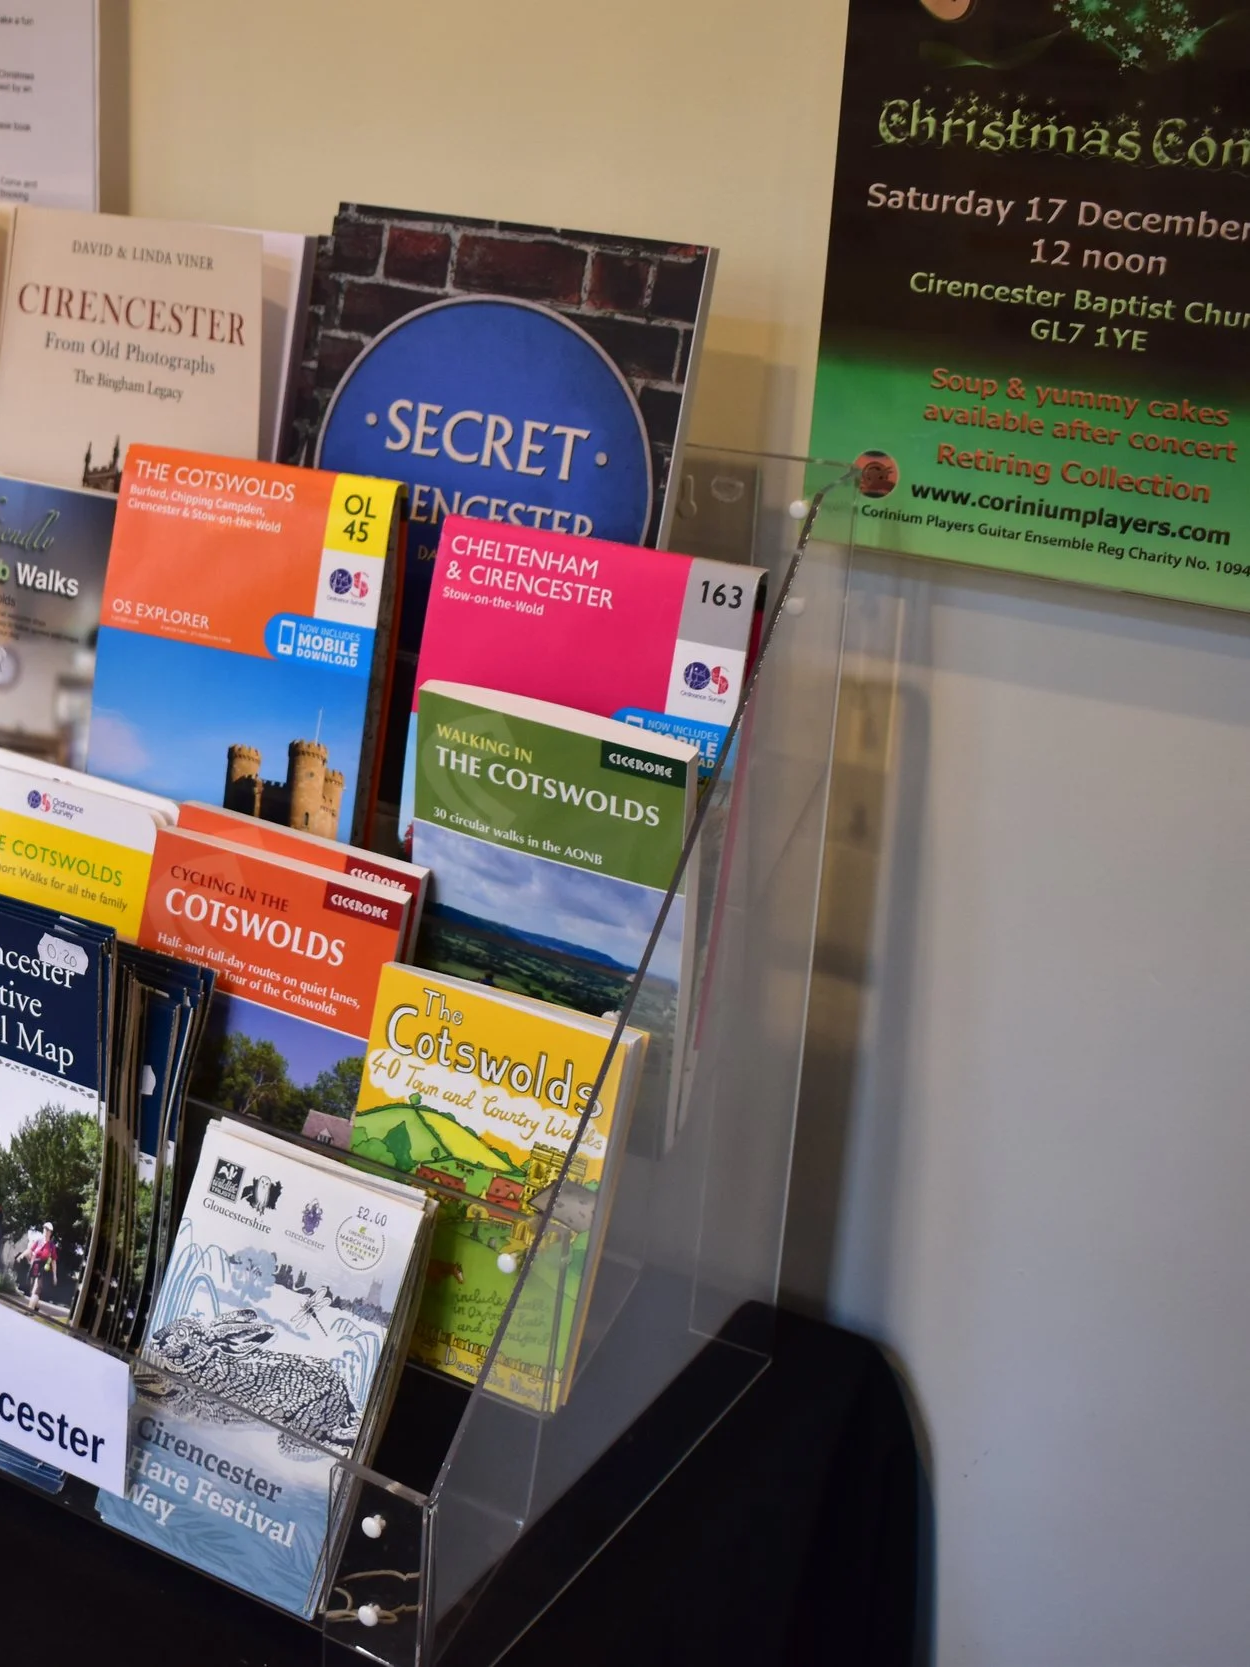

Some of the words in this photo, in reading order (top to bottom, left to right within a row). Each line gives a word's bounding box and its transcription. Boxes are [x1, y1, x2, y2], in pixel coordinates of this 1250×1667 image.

[878, 98, 1143, 162] Christmas
[867, 183, 1014, 226] Saturday
[1025, 198, 1067, 224] 17
[1078, 201, 1250, 242] December
[72, 240, 113, 257] DAVID
[117, 246, 128, 259] &
[132, 247, 173, 265] LINDA
[176, 253, 214, 270] VINER
[1030, 239, 1071, 266] 12
[1082, 247, 1168, 276] noon
[18, 281, 246, 346] CIRENCESTER
[910, 273, 1065, 308] Cirencester
[1074, 289, 1176, 321] Baptist
[45, 331, 85, 353] From
[91, 338, 119, 359] Old
[125, 343, 216, 376] Photographs
[1030, 319, 1084, 344] GL7
[1095, 327, 1149, 352] 1YE
[931, 368, 998, 399] Soup
[1006, 377, 1026, 400] &
[1036, 384, 1140, 420] yummy
[1147, 399, 1230, 427] cakes
[384, 399, 591, 481] SECRET
[924, 402, 1044, 436] available
[1052, 419, 1122, 445] after
[1129, 432, 1238, 462] concert
[136, 459, 170, 483] THE
[174, 466, 296, 502] COTSWOLDS
[936, 443, 1052, 485] Retiring
[1061, 461, 1211, 503] Collection
[128, 498, 180, 518] Cirencester
[182, 506, 190, 518] &
[192, 507, 281, 534] Stow-on-the-Wold
[130, 484, 169, 502] Burford,
[171, 490, 213, 509] Chipping
[215, 497, 266, 518] Campden,
[344, 494, 376, 520] OL
[911, 484, 1231, 546] www.coriniumplayers.com
[343, 521, 369, 542] 45
[861, 505, 923, 525] Corinium
[926, 514, 975, 534] Players
[978, 522, 1022, 541] Guitar
[1024, 530, 1094, 552] Ensemble
[1097, 541, 1125, 560] Reg
[1128, 546, 1182, 568] Charity
[1185, 556, 1211, 571] No.
[16, 562, 79, 597] Walks
[451, 535, 599, 579] CHELTENHAM
[442, 585, 544, 617] Stow-on-the-Wold
[446, 560, 461, 580] &
[469, 564, 613, 610] CIRENCESTER
[701, 580, 743, 610] 163
[296, 648, 358, 668] DOWNLOAD
[298, 633, 359, 658] MOBILE
[436, 723, 510, 758] WALKING
[514, 746, 533, 764] IN
[608, 752, 672, 778] CICERONE
[435, 745, 481, 780] THE
[488, 763, 660, 827] COTSWOLDS
[433, 806, 447, 820] 30
[450, 811, 490, 834] circular
[493, 828, 524, 844] walks
[528, 835, 539, 848] in
[542, 840, 561, 854] the
[564, 846, 603, 866] AONB
[12, 840, 123, 887] COTSWOLDS
[19, 867, 48, 885] Walks
[51, 877, 65, 891] for
[67, 882, 79, 894] all
[81, 887, 97, 901] the
[99, 892, 127, 913] family
[170, 865, 236, 896] CYCLING
[240, 886, 256, 901] IN
[260, 892, 289, 912] THE
[331, 893, 389, 920] CICERONE
[166, 888, 346, 967] COTSWOLDS
[158, 932, 182, 948] Half-
[185, 941, 205, 956] and
[207, 948, 246, 976] full-day
[248, 961, 281, 982] routes
[283, 974, 297, 986] on
[300, 976, 328, 999] quiet
[330, 987, 360, 1010] lanes,
[423, 988, 464, 1026] The
[16, 1021, 74, 1075] Map
[386, 1004, 604, 1118] Cotswolds
[371, 1051, 401, 1078] 40
[404, 1064, 439, 1098] Town
[442, 1090, 476, 1110] and
[482, 1094, 541, 1140] Country
[203, 1197, 272, 1234] Gloucestershire
[137, 1416, 282, 1502] Cirencester
[125, 1477, 176, 1526] Way
[129, 1445, 190, 1495] Hare
[192, 1476, 296, 1548] Festival
